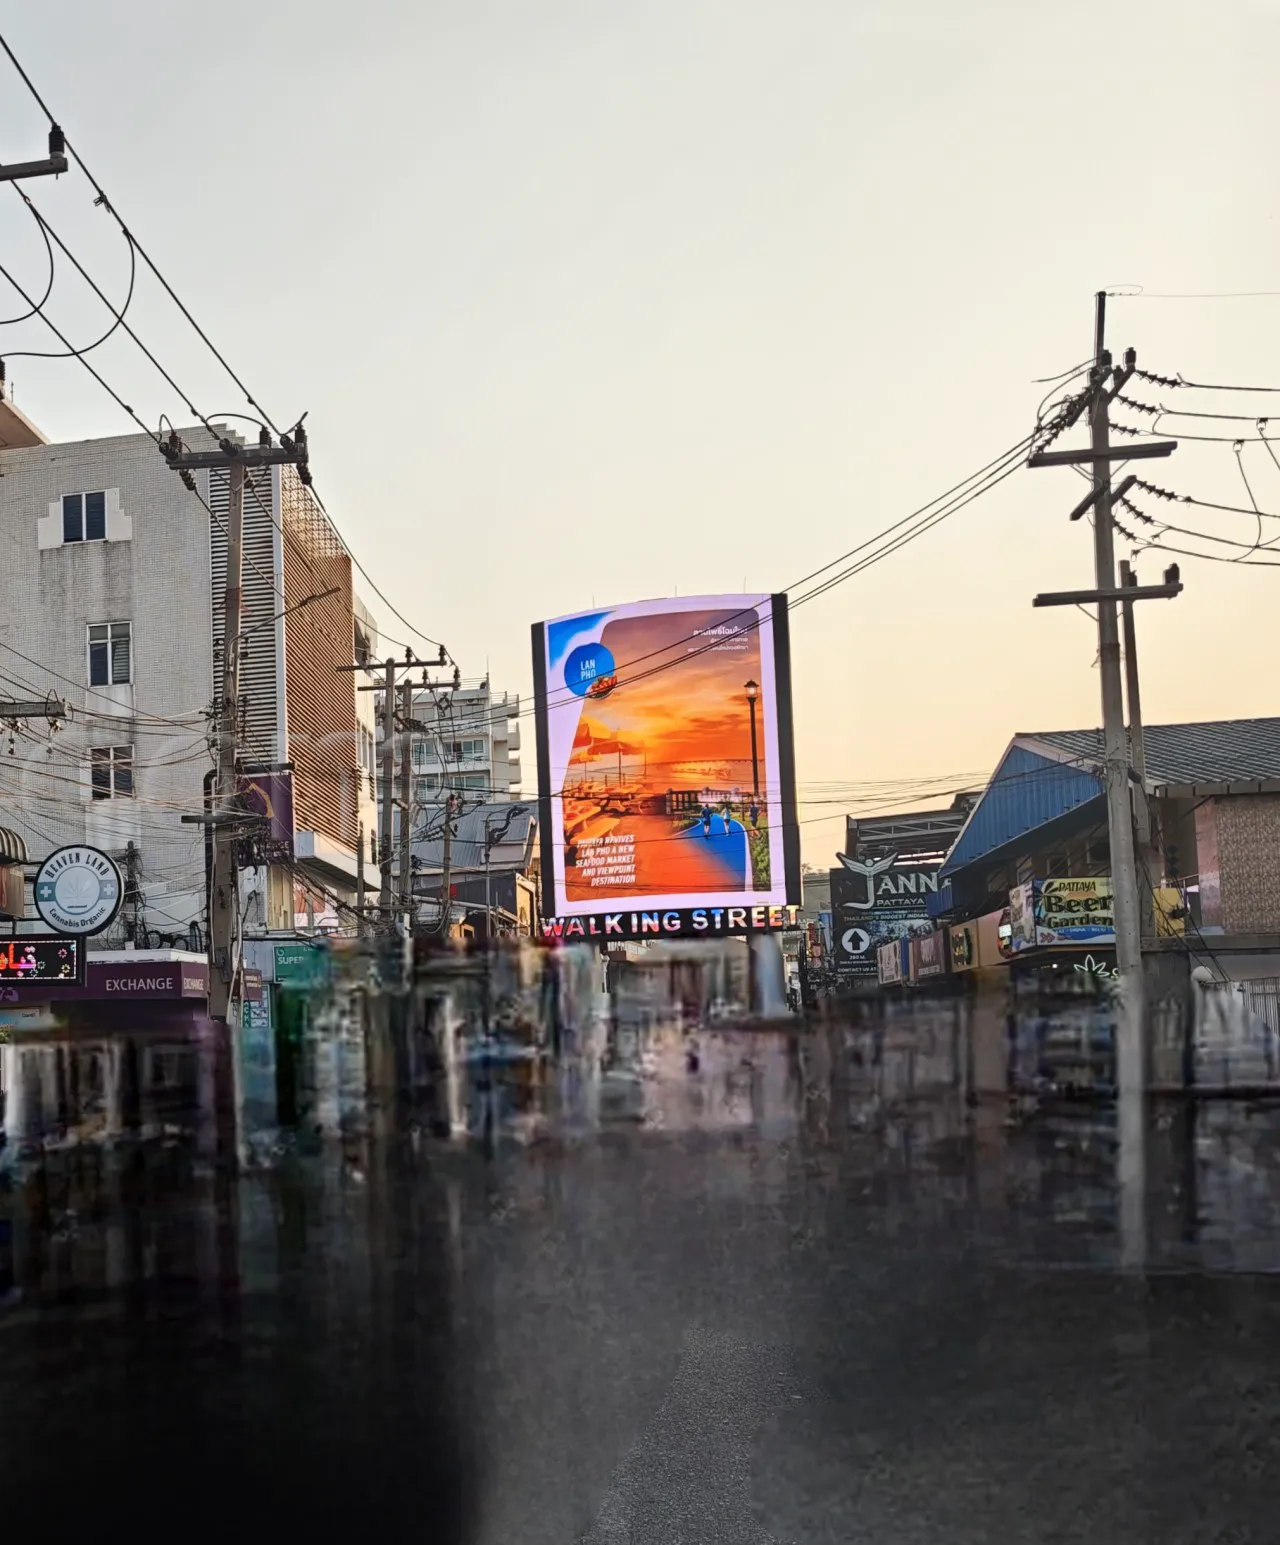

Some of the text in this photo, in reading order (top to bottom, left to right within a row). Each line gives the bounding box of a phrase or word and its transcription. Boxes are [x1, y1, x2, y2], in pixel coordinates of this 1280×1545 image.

[580, 659, 596, 671] LAN
[581, 847, 595, 858] LAN
[595, 846, 611, 856] PHO
[618, 845, 635, 853] NEW
[44, 852, 110, 879] HEAVEN LAND
[575, 855, 636, 869] SEAFOOD MARKET
[582, 864, 637, 877] AND VIEWPOINT
[591, 874, 637, 887] DESTINATION
[1058, 881, 1096, 892] PATTAYA
[876, 897, 925, 907] PATTAYA
[1044, 894, 1115, 913] Beer
[49, 906, 107, 928] Cannabis Organic
[540, 910, 682, 938] WALKING
[692, 905, 800, 930] STREET
[1047, 914, 1114, 928] Garden
[105, 977, 174, 992] EXCHANGE
[183, 977, 204, 992] EXCHANGE
